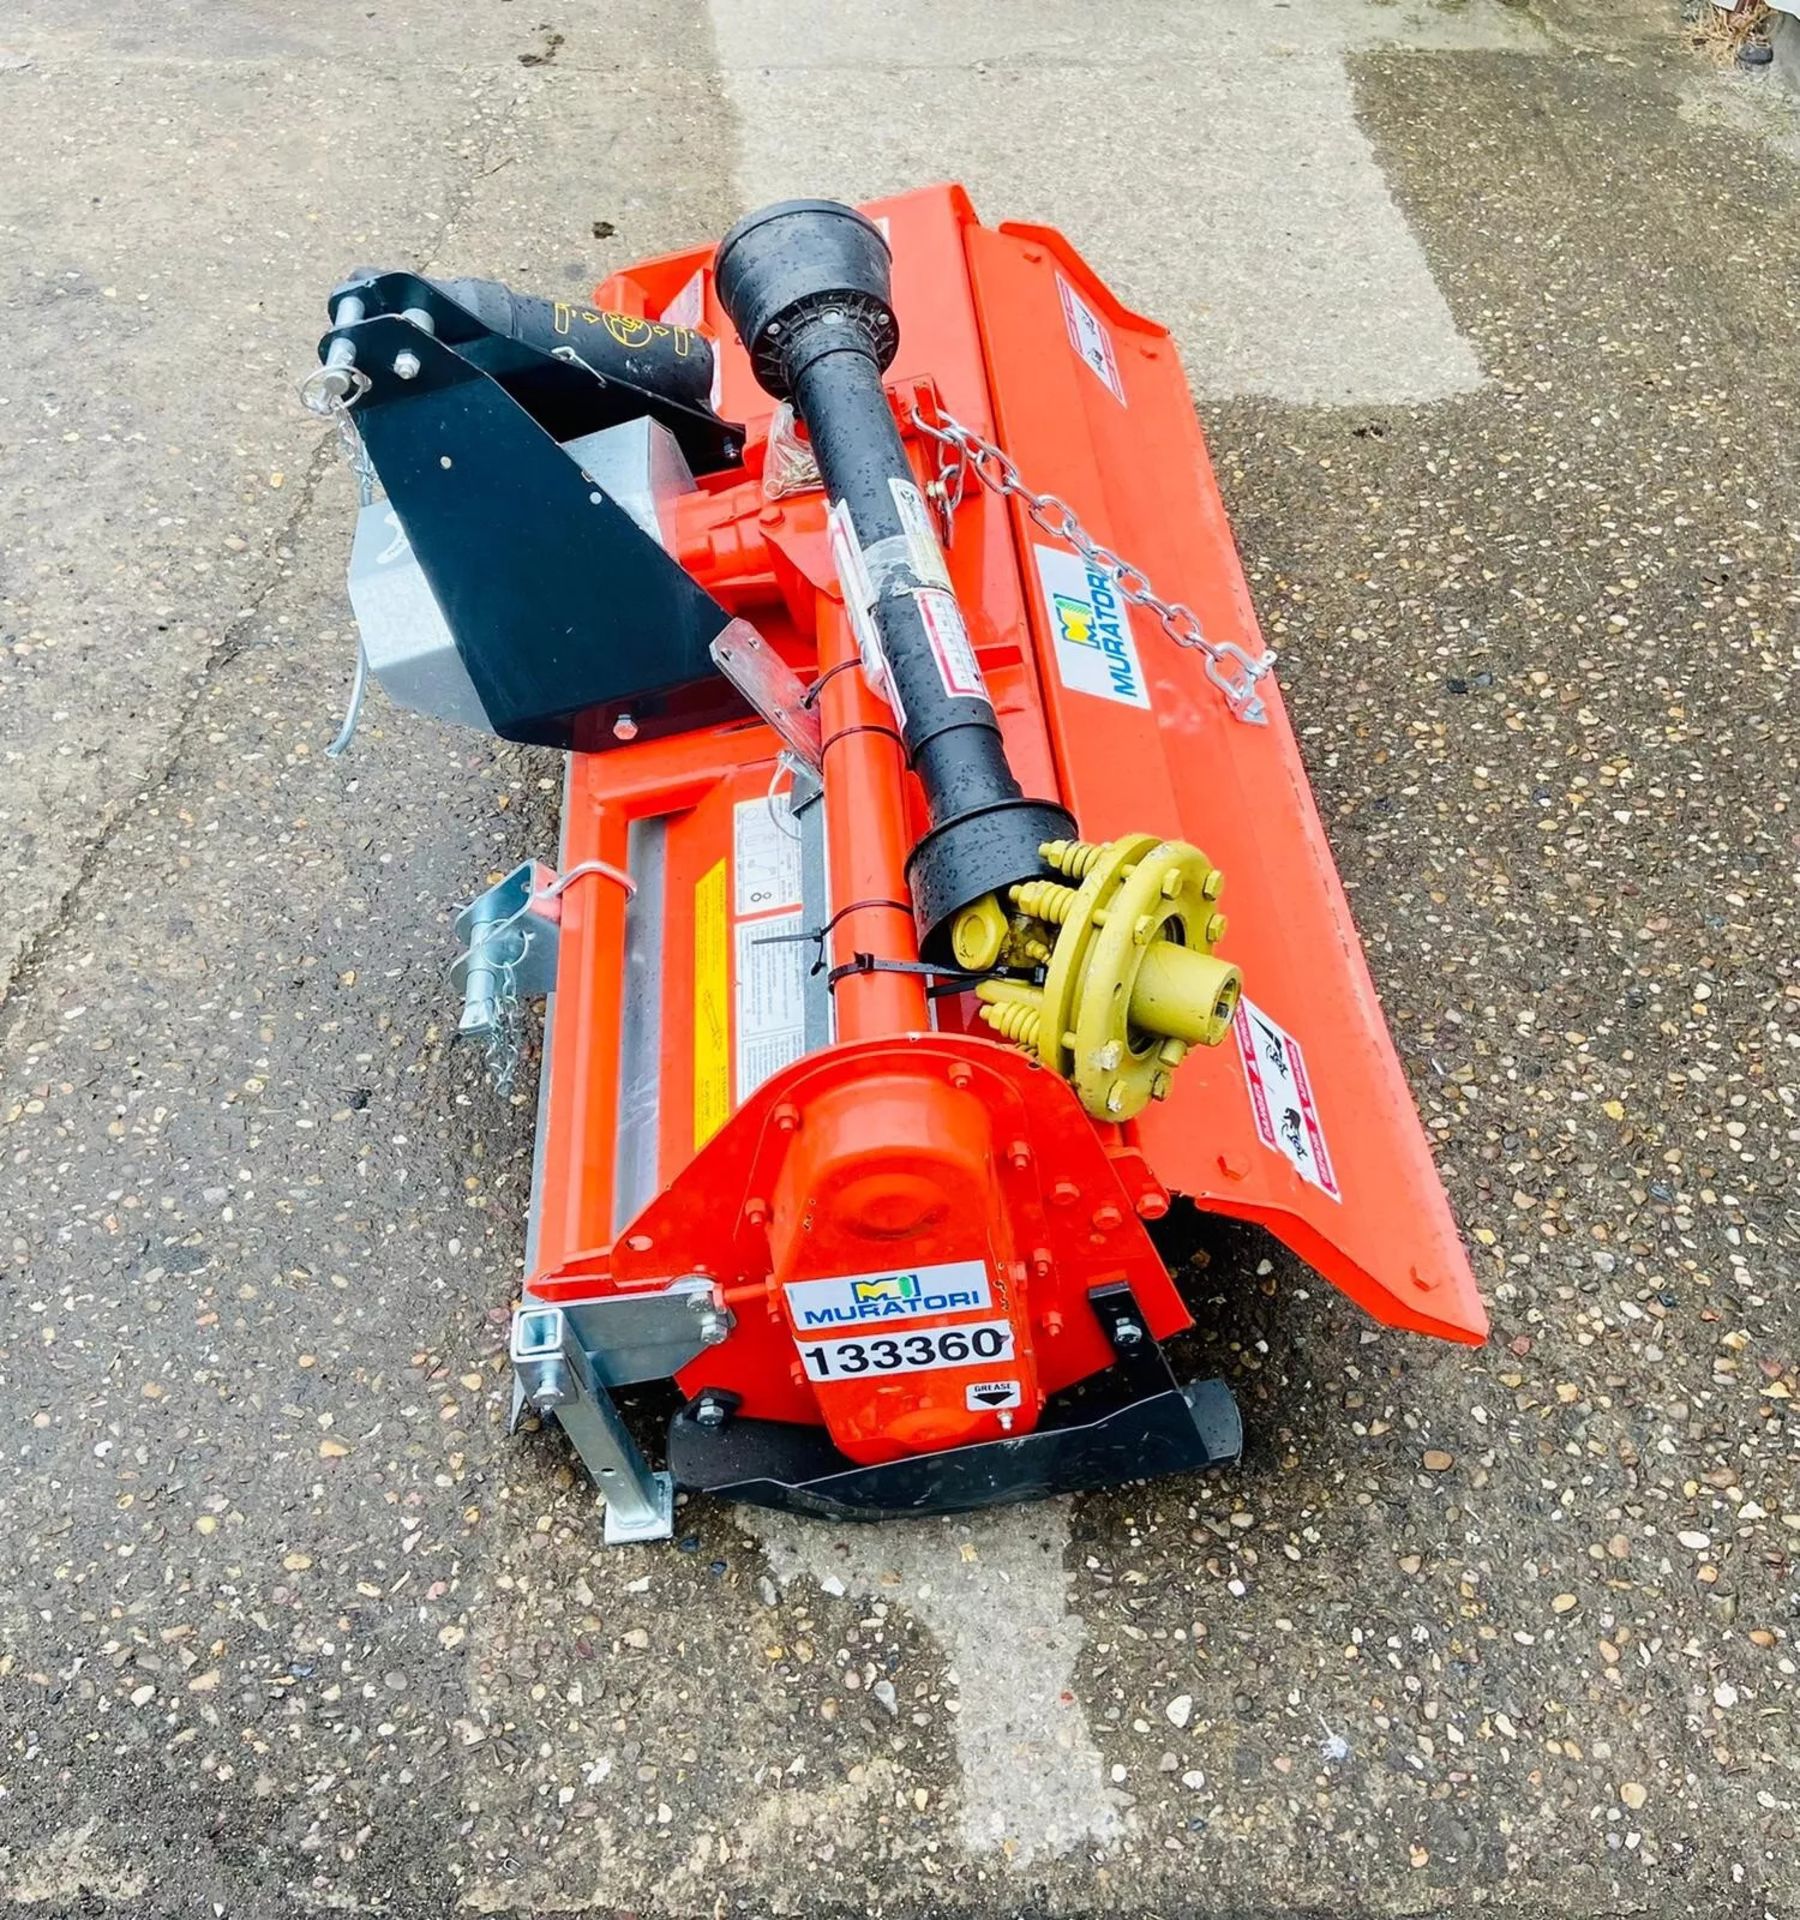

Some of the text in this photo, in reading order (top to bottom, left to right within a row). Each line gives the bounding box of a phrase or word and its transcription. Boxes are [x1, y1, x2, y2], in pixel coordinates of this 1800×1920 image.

[804, 1290, 980, 1325] MURATORI
[805, 1327, 1003, 1376] 133360
[974, 1383, 1011, 1392] GREASE
